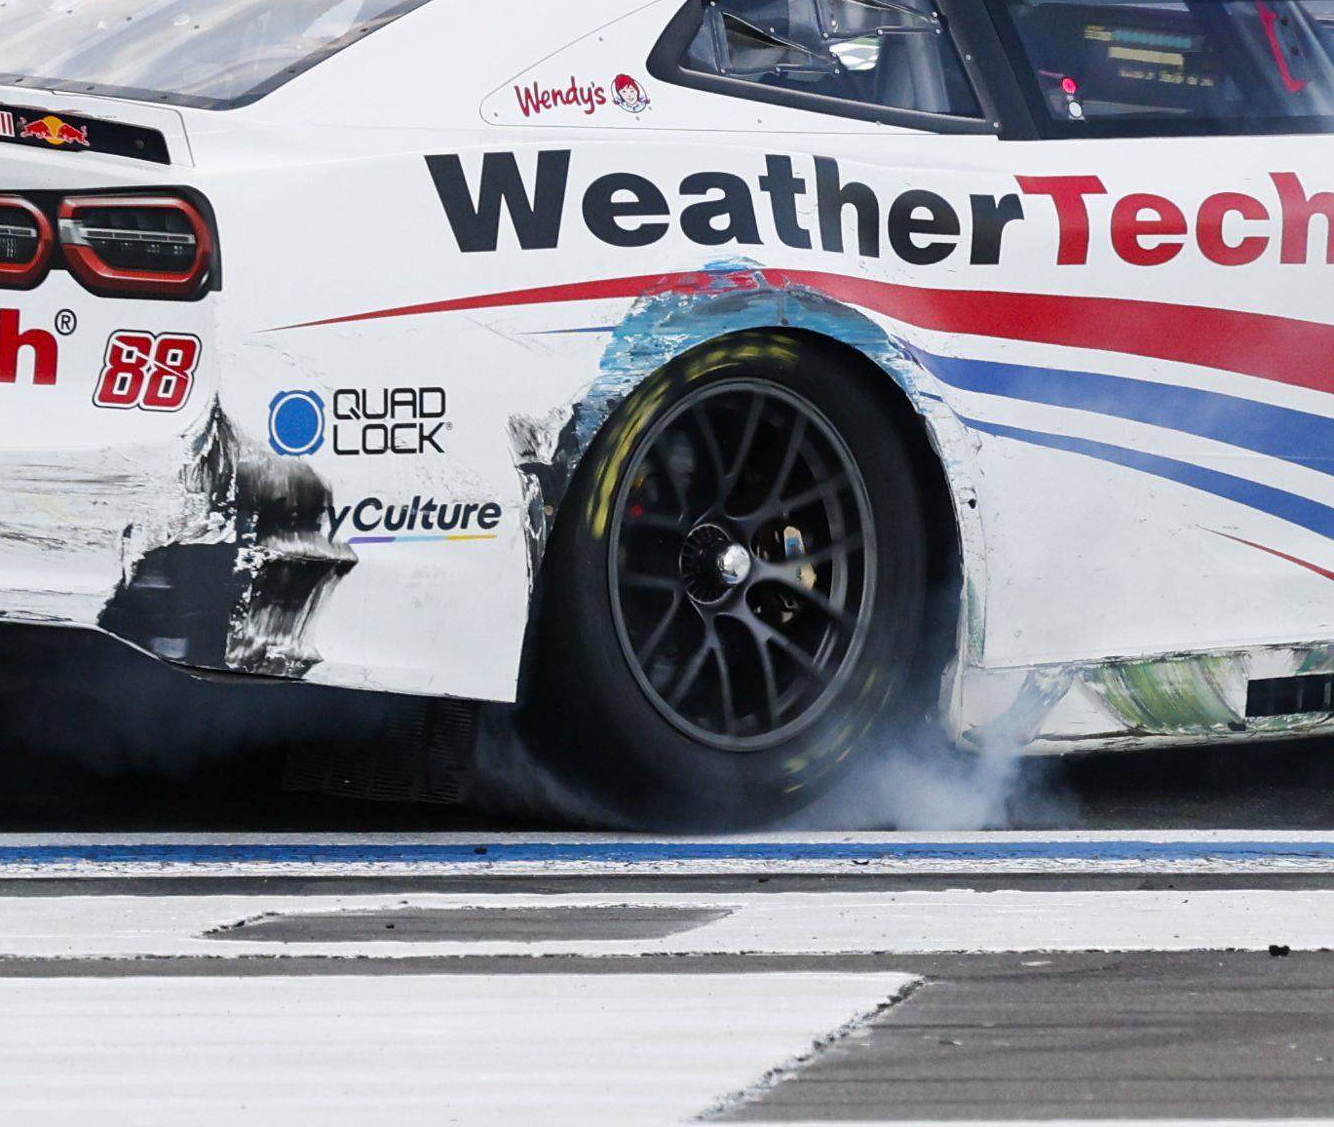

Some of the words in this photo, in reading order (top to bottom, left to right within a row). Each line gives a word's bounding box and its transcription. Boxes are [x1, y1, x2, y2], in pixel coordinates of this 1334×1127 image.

[513, 76, 607, 118] Wendy's
[92, 328, 202, 413] 88
[333, 387, 446, 420] QUAD
[333, 422, 447, 455] LOCK
[328, 495, 502, 543] yCulture
